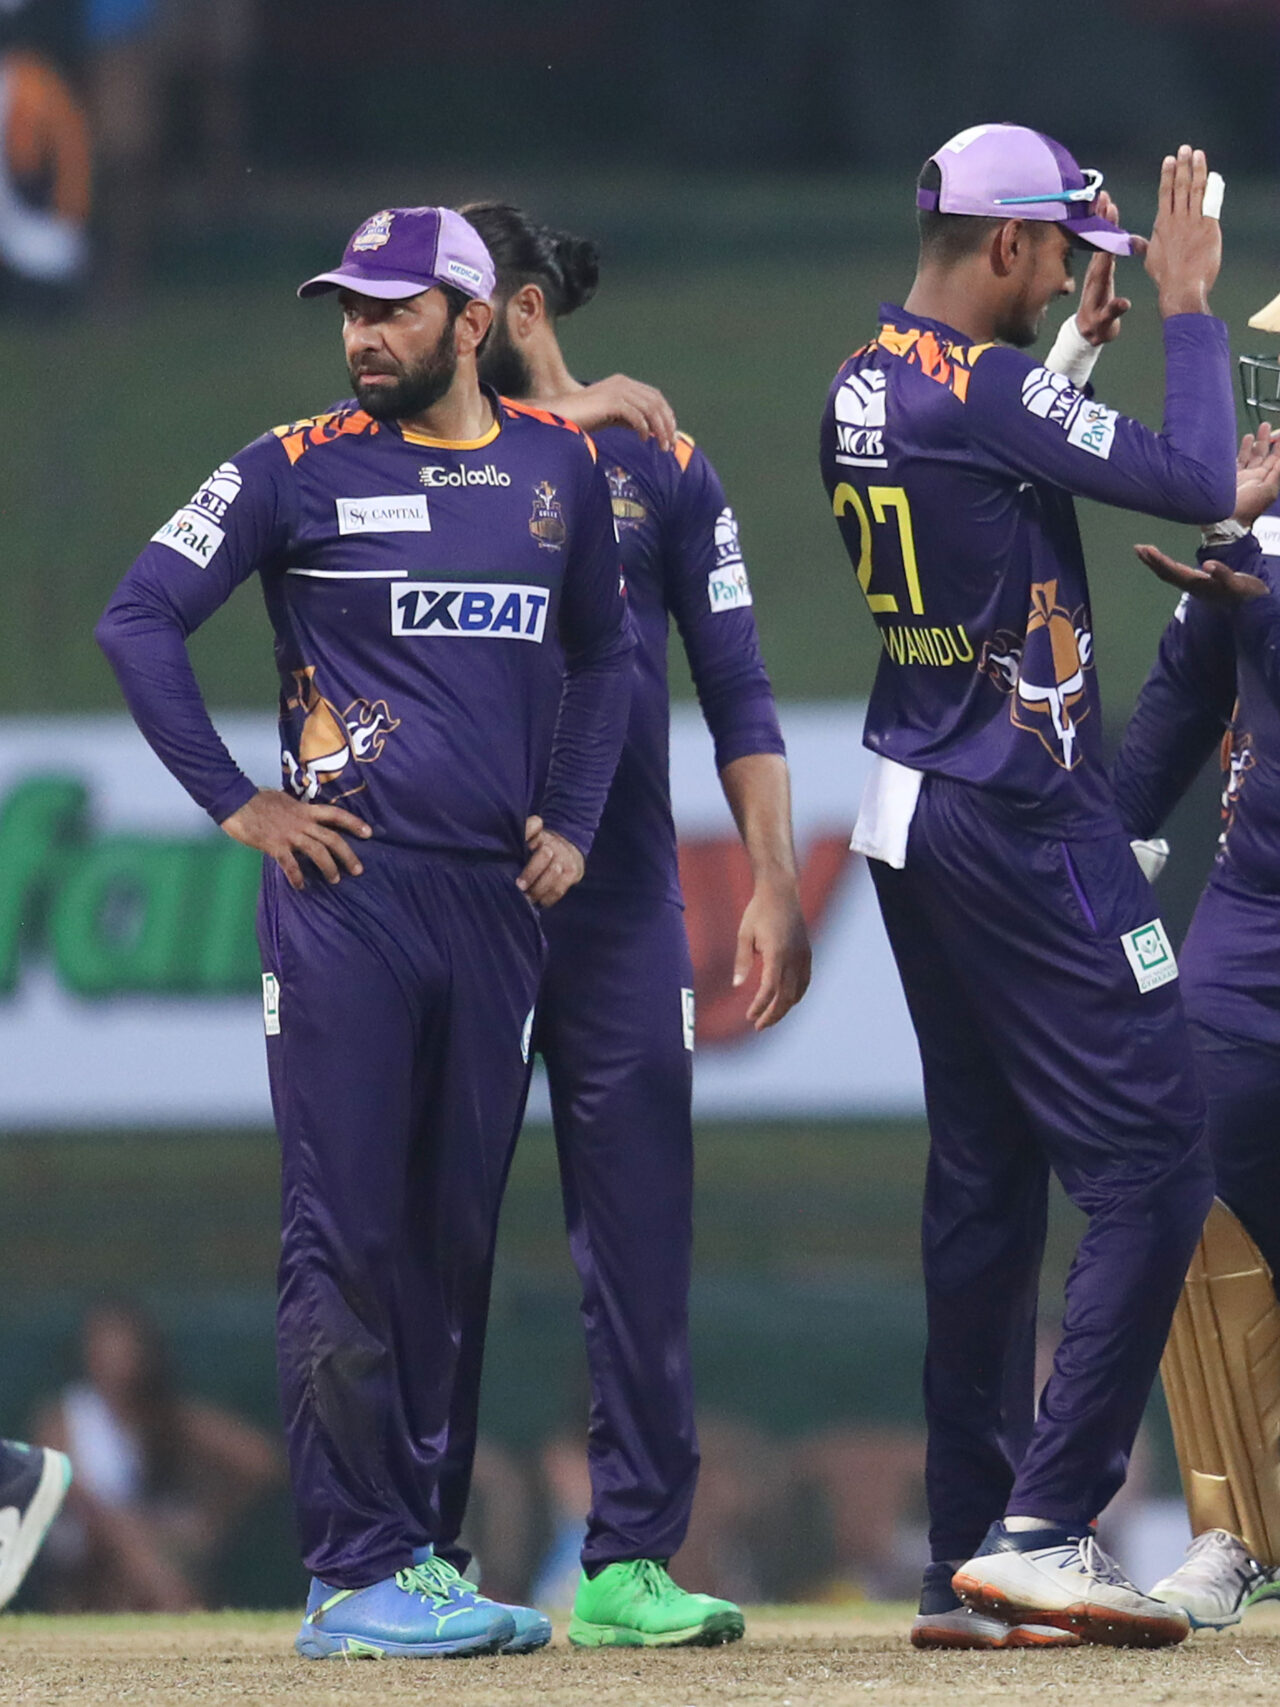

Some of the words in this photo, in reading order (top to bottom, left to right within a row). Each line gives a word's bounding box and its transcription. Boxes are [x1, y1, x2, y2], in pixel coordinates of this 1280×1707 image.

[836, 425, 884, 455] MCB
[190, 491, 228, 517] CB
[372, 507, 424, 520] CAPITAL
[833, 482, 924, 615] 27
[397, 590, 547, 635] 1XBAT
[880, 625, 974, 667] WANIDU
